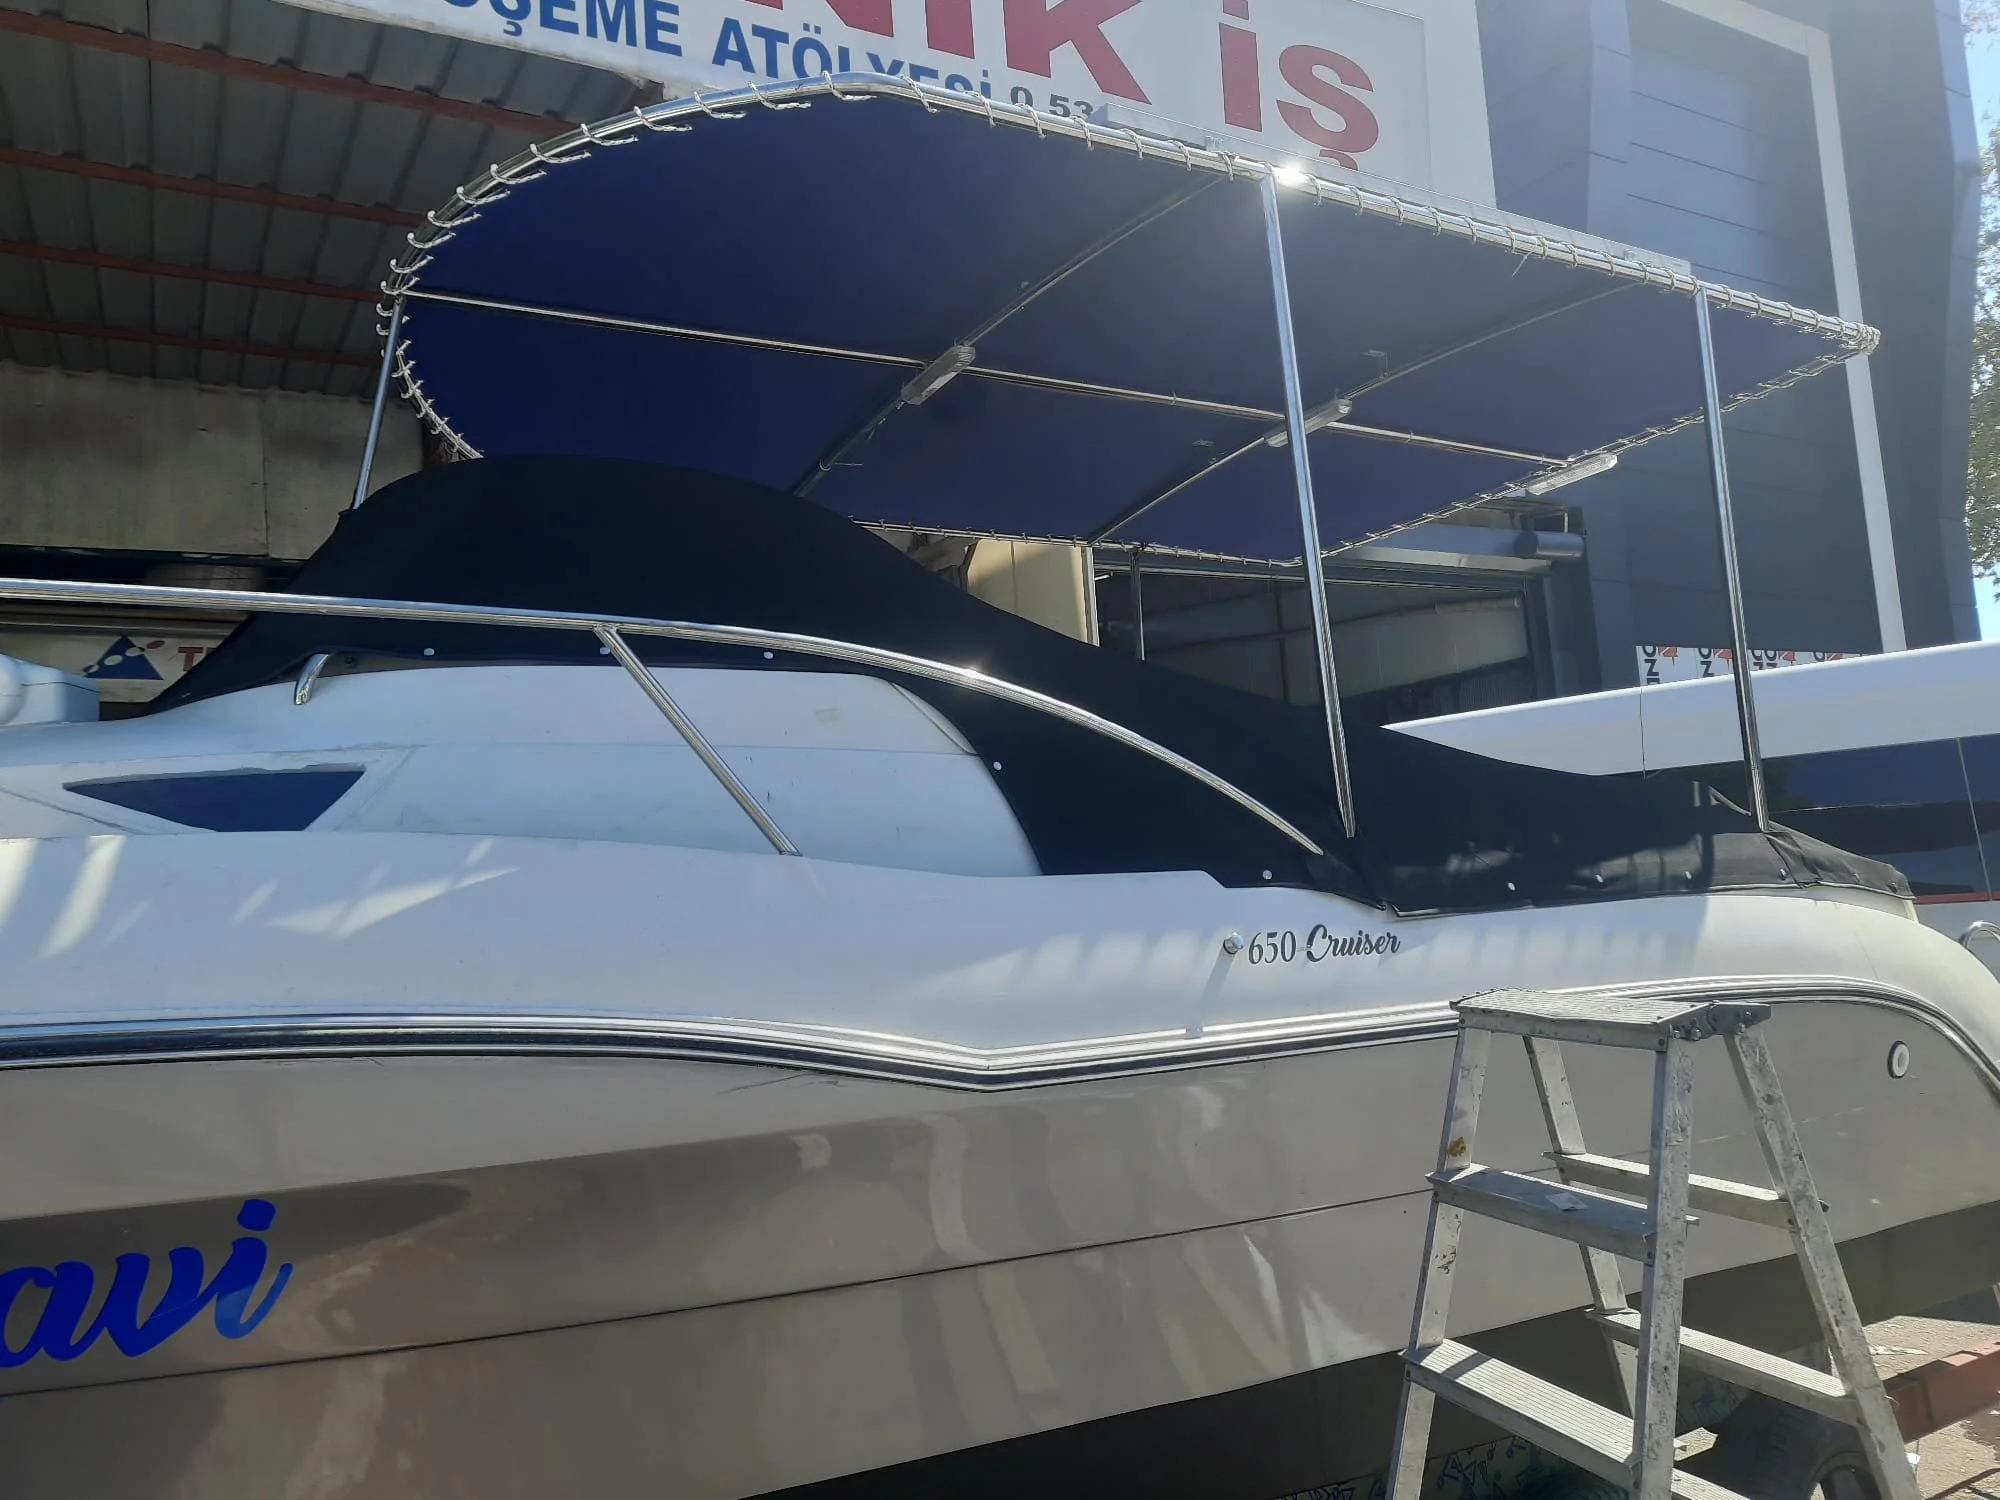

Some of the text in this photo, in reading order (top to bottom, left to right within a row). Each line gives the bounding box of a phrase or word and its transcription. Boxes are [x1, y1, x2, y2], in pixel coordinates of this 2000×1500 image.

[443, 0, 682, 57] ŞEME
[1249, 923, 1401, 965] 650 Cruiser
